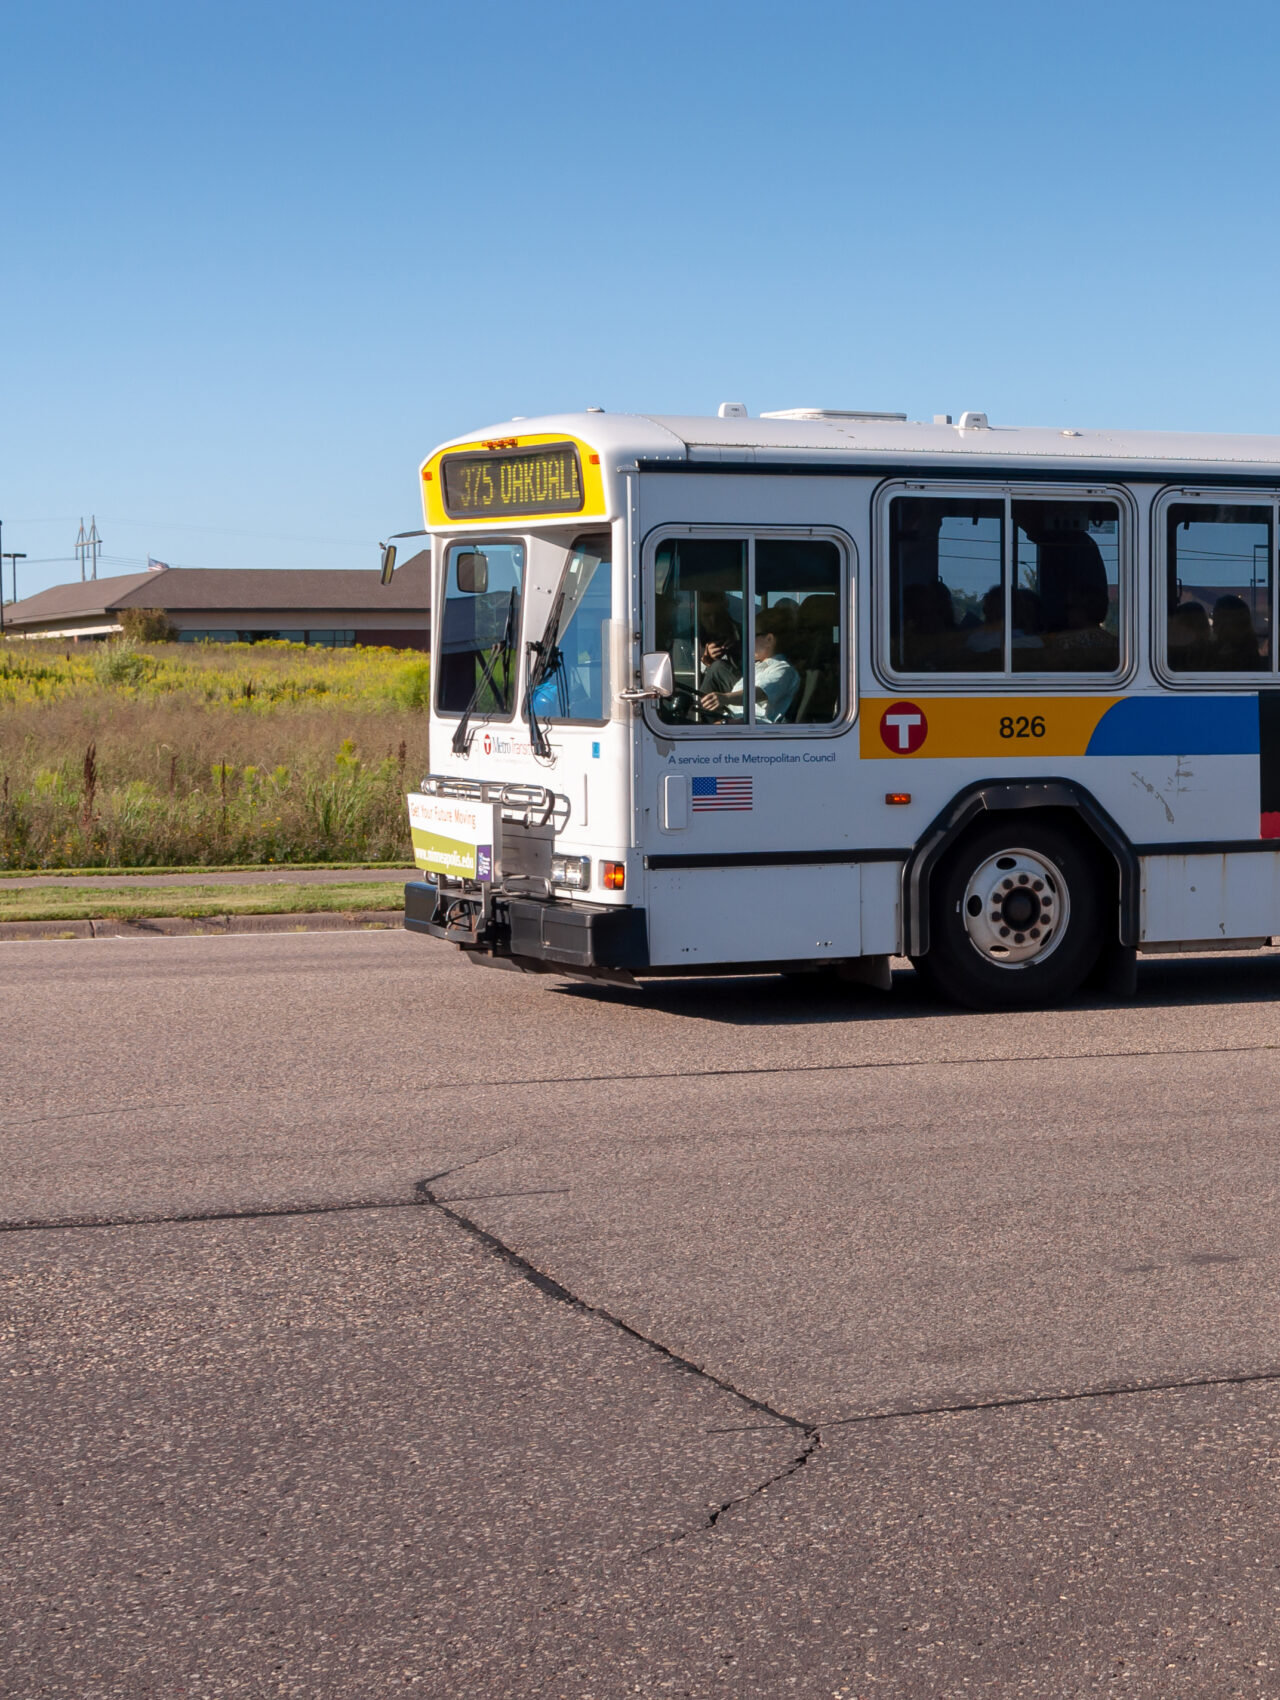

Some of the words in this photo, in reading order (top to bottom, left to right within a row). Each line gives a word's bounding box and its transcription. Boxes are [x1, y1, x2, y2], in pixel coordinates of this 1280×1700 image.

[460, 464, 494, 506] 375
[886, 714, 921, 749] T
[999, 715, 1046, 739] 826
[668, 755, 676, 764] A
[678, 755, 710, 764] service
[712, 754, 721, 764] of
[724, 754, 739, 763] the
[742, 753, 801, 765] Metropolitan
[802, 752, 836, 763] Council
[454, 807, 476, 830] Moving
